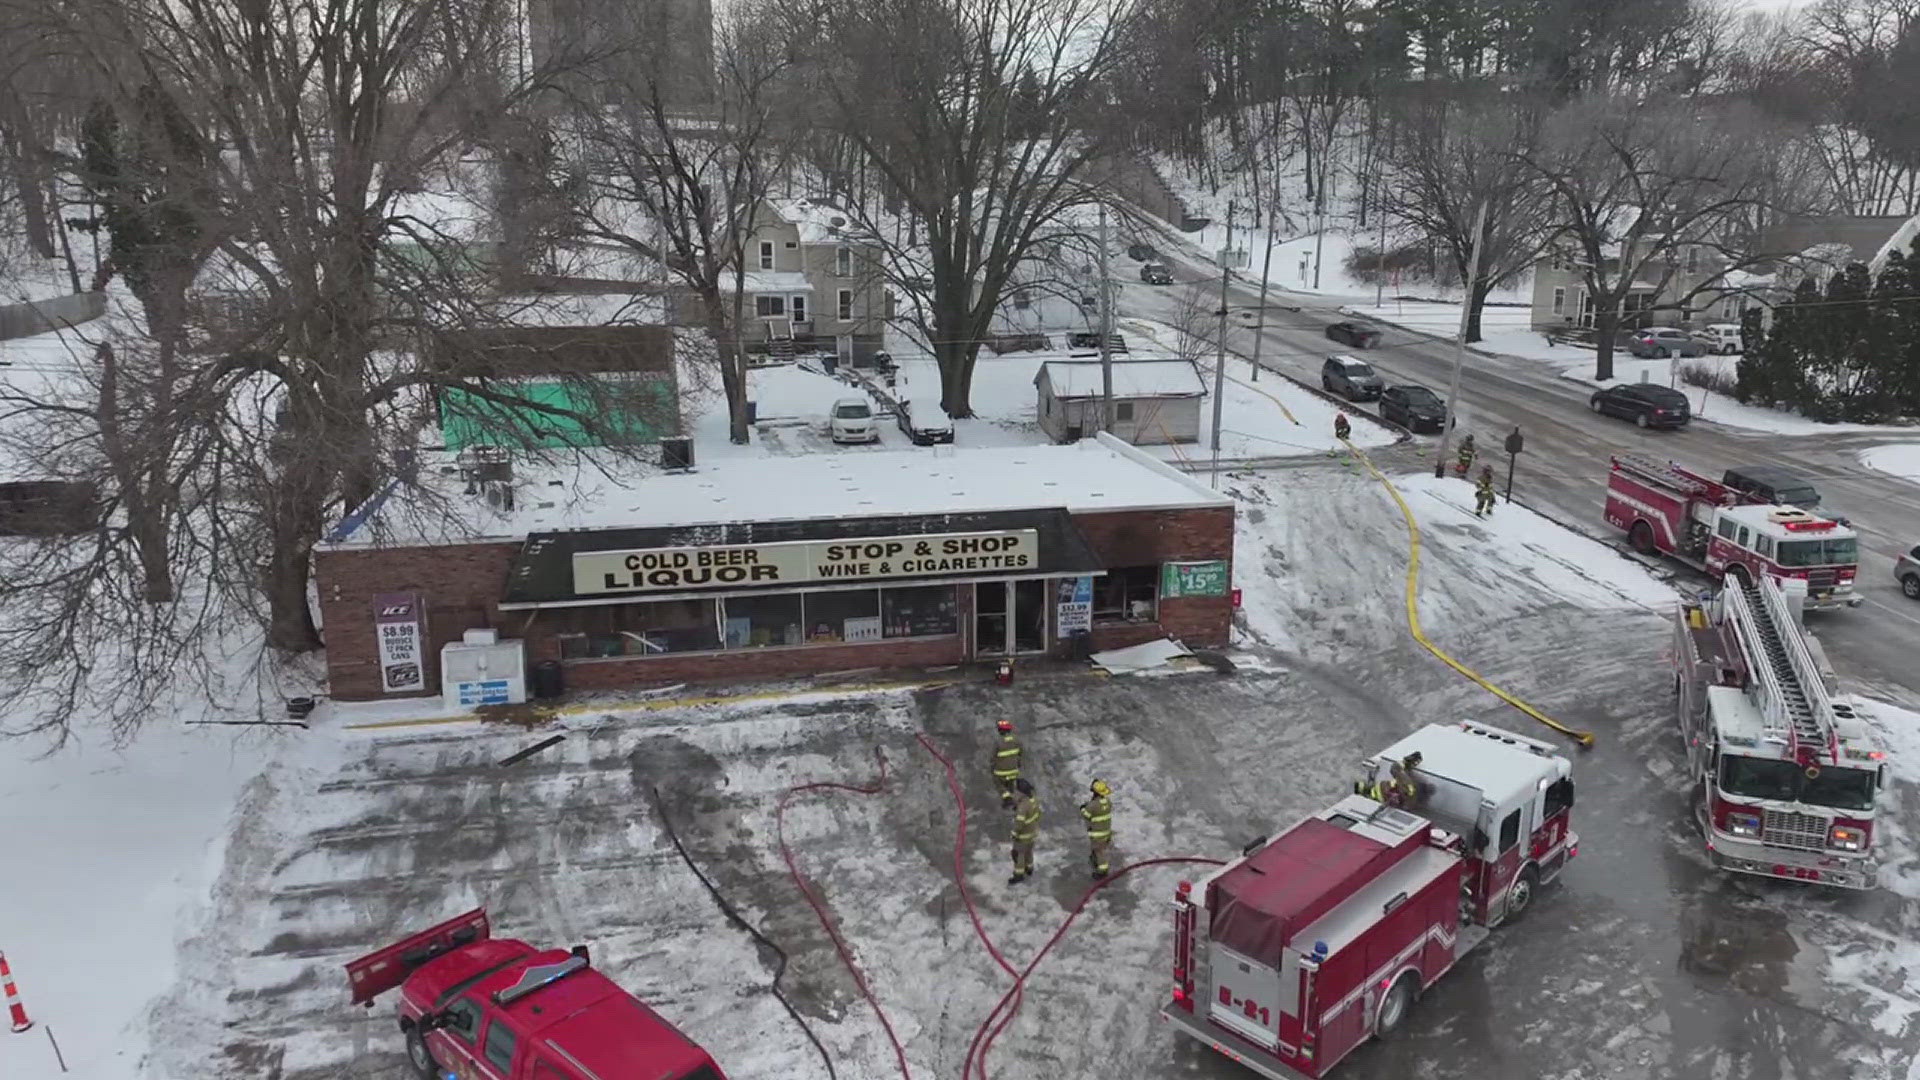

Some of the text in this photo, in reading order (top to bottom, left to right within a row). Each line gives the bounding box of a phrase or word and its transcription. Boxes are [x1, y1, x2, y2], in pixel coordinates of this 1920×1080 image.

[827, 536, 1019, 561] STOP & SHOP
[625, 549, 758, 571] COLD BEER
[818, 554, 1029, 577] WINE & CIGARETTES
[604, 565, 780, 589] LIQUOR
[383, 625, 413, 637] $8.99
[391, 652, 410, 660] CANS
